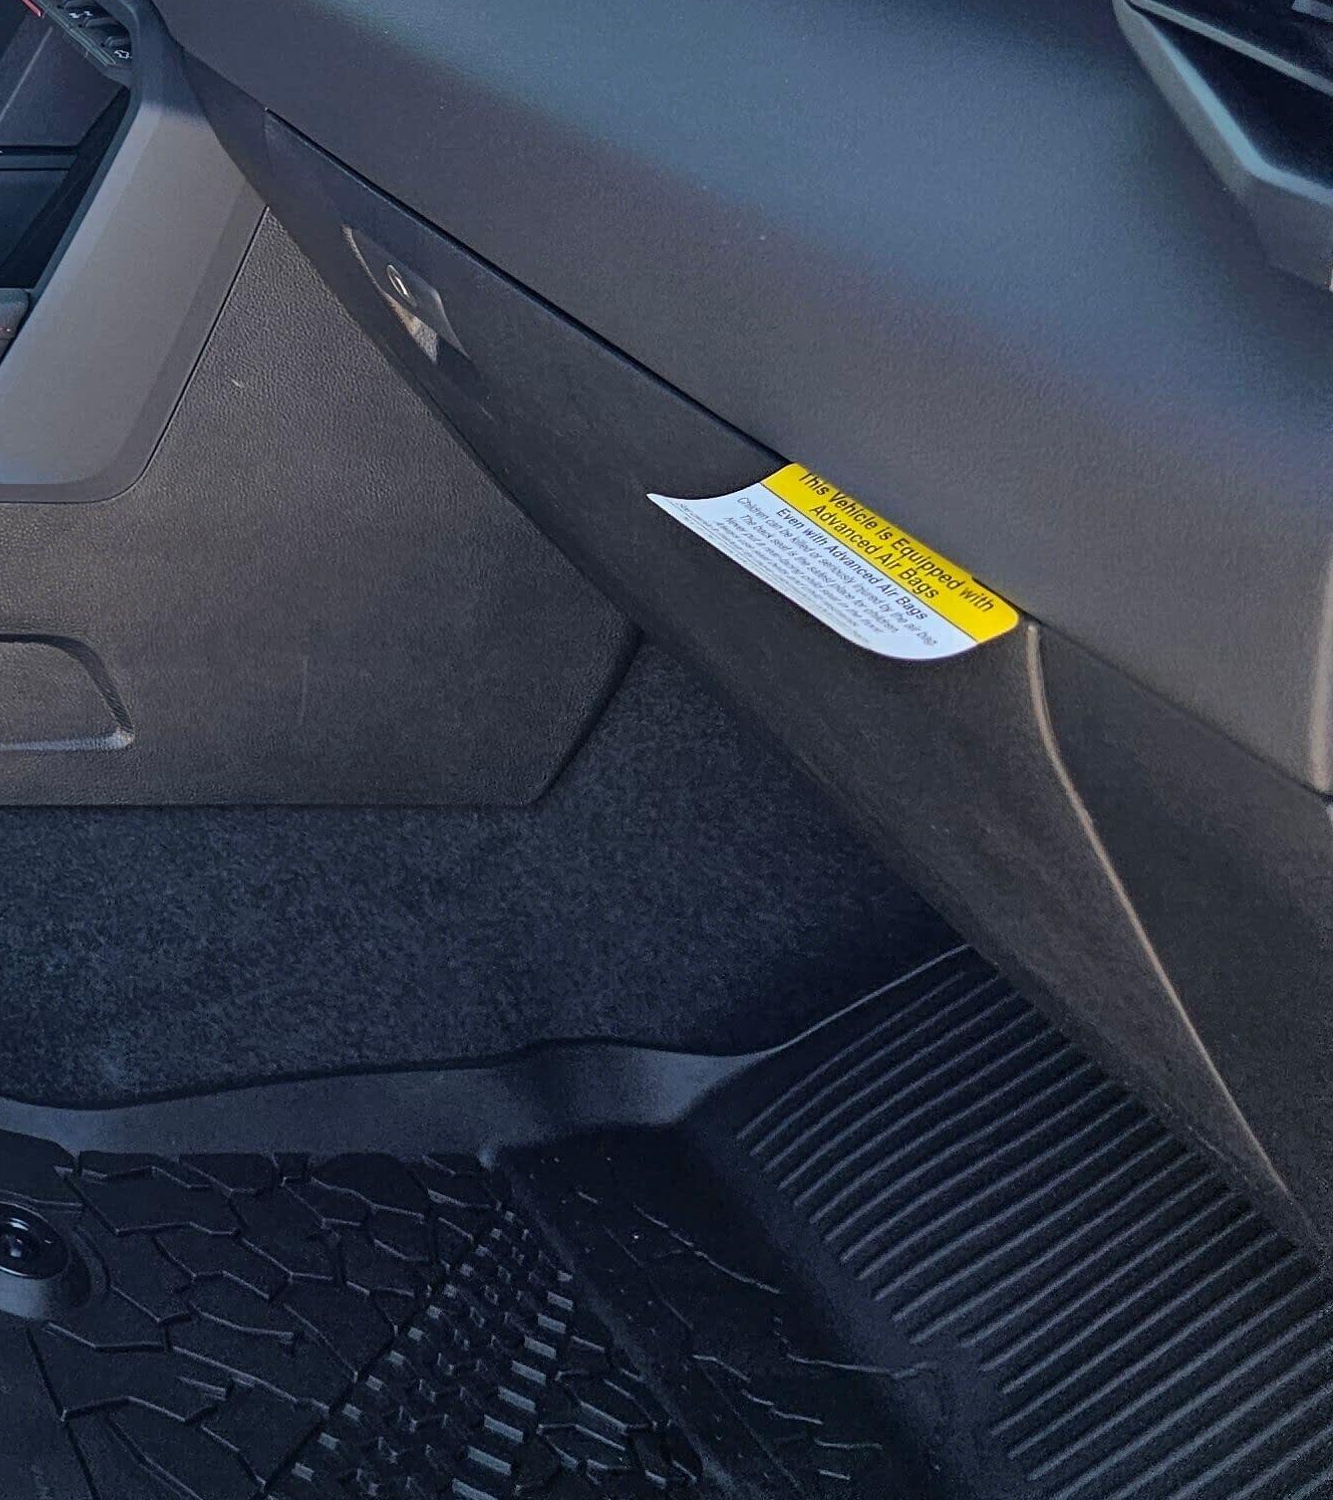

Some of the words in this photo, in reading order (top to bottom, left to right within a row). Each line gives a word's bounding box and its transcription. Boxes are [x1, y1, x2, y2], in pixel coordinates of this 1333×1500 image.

[776, 507, 805, 530] Even
[802, 526, 829, 546] with
[826, 544, 883, 585] Advanced
[879, 580, 899, 598] Air
[896, 595, 929, 620] Bags
[799, 472, 830, 496] This
[828, 491, 877, 530] Vehicle
[876, 526, 893, 541] is
[891, 537, 963, 591] Equipped
[959, 586, 995, 613] with
[809, 505, 883, 555] Advanced
[875, 550, 903, 570] Air
[898, 567, 940, 599] Bags
